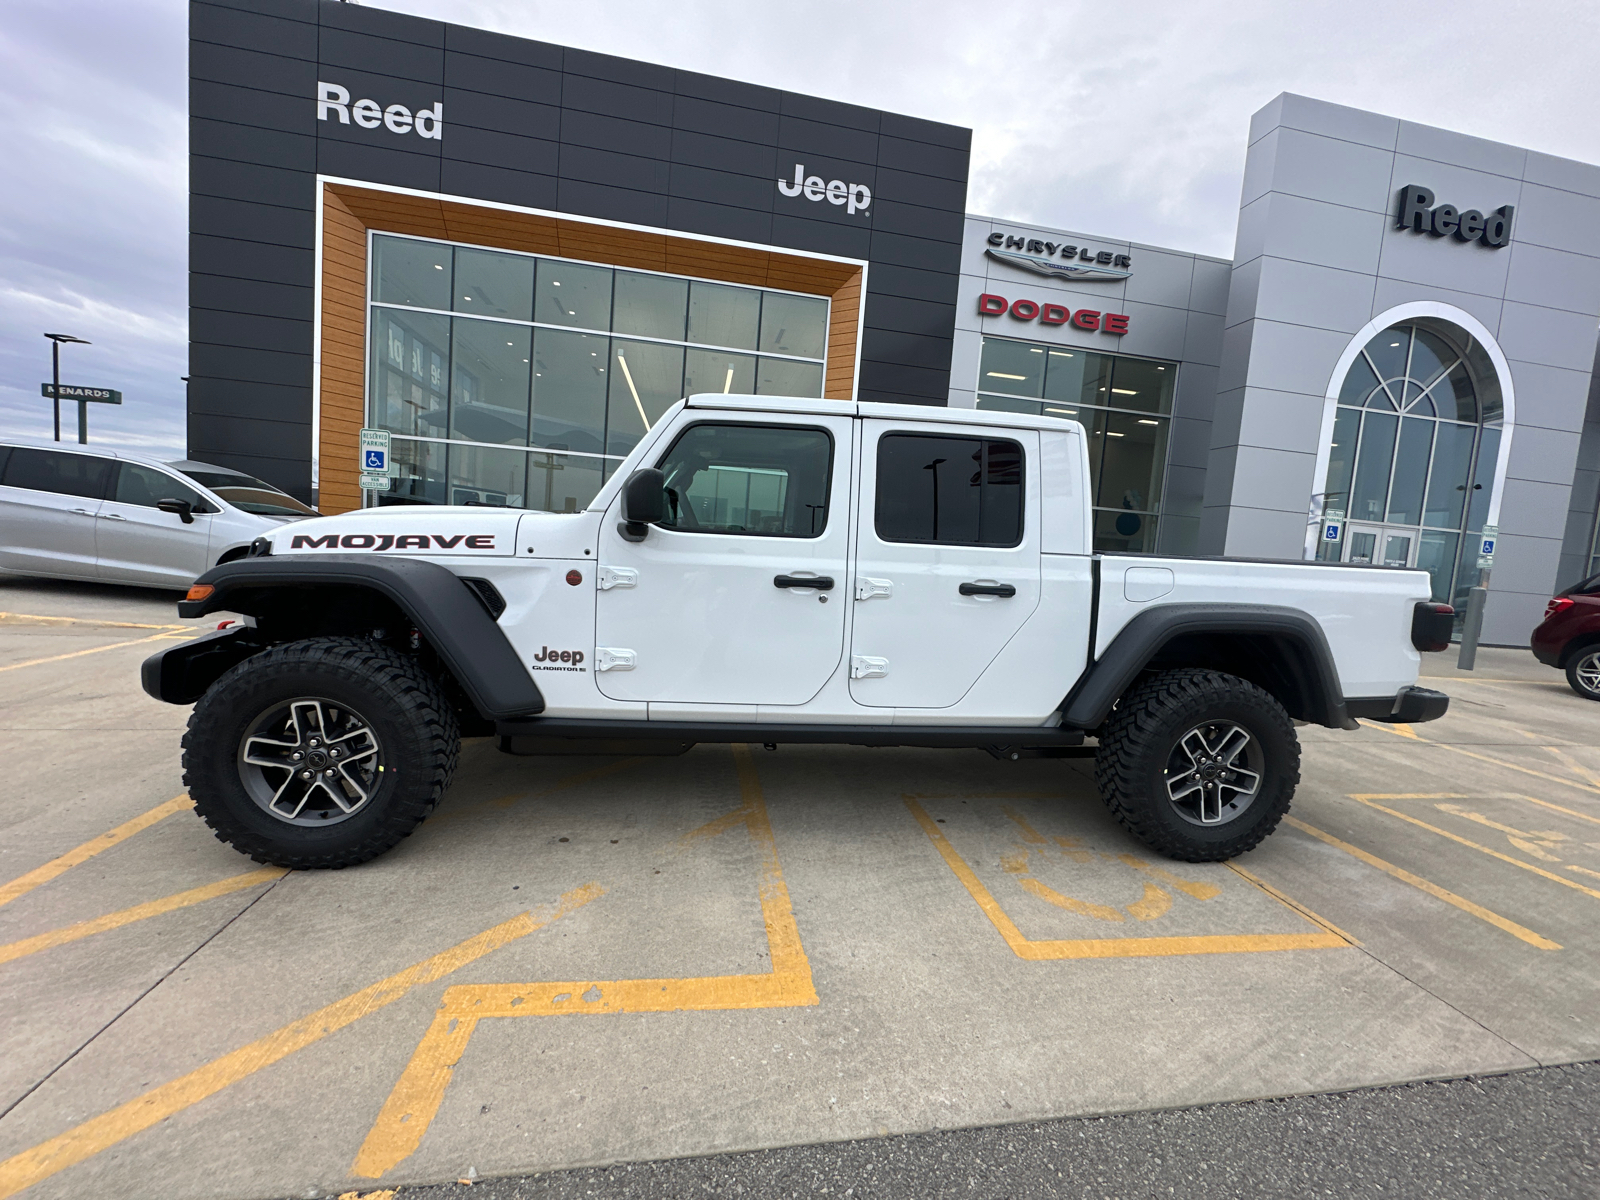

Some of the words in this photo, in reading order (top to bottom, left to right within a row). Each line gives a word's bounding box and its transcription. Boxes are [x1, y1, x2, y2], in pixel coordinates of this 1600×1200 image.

[317, 81, 443, 140] Reed
[777, 163, 872, 215] Jeep
[1399, 184, 1515, 248] Reed
[987, 232, 1131, 267] CHRYSLER
[979, 292, 1131, 335] DODGE
[362, 432, 388, 441] RESERVED
[362, 439, 388, 448] PARKING
[290, 534, 496, 551] MOJAVE
[534, 645, 584, 666] Jeep
